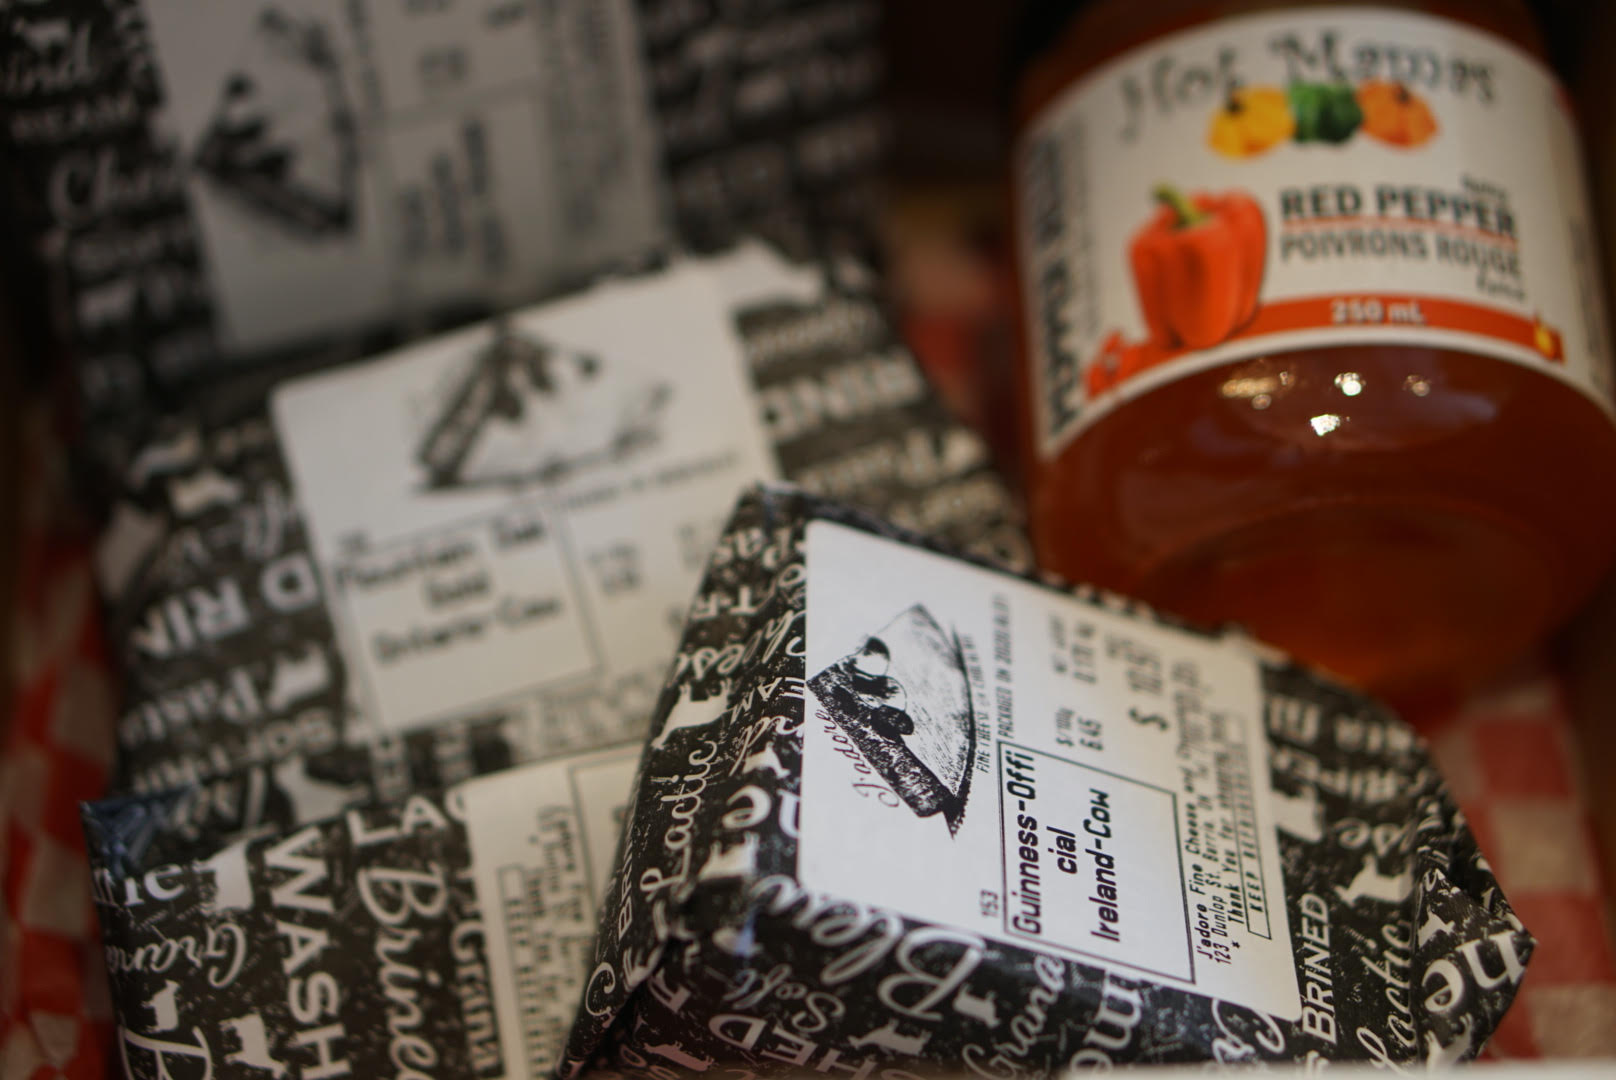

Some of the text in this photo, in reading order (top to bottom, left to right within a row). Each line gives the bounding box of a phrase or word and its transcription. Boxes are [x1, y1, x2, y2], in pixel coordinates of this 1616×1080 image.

[1280, 184, 1362, 220] RED
[1374, 184, 1516, 237] PEPPER
[1280, 230, 1428, 262] POIVRONS
[1331, 299, 1383, 324] 250
[997, 686, 1014, 740] PACKAGED
[1128, 706, 1169, 732] $
[639, 739, 718, 903] Lactic
[1007, 750, 1042, 936] Guinness-Offi
[1184, 802, 1200, 855] Cheese
[1046, 827, 1078, 876] cial
[1083, 788, 1121, 943] Ireland-Cow
[1221, 850, 1237, 874] You
[1189, 863, 1205, 896] Fine
[1245, 870, 1264, 914] KEEP
[980, 889, 999, 918] 153
[1210, 894, 1228, 939] Dunlop
[1223, 883, 1245, 925] Thank
[1193, 902, 1214, 960] J'adore
[1213, 940, 1232, 965] 123
[1301, 892, 1338, 1045] BRINED
